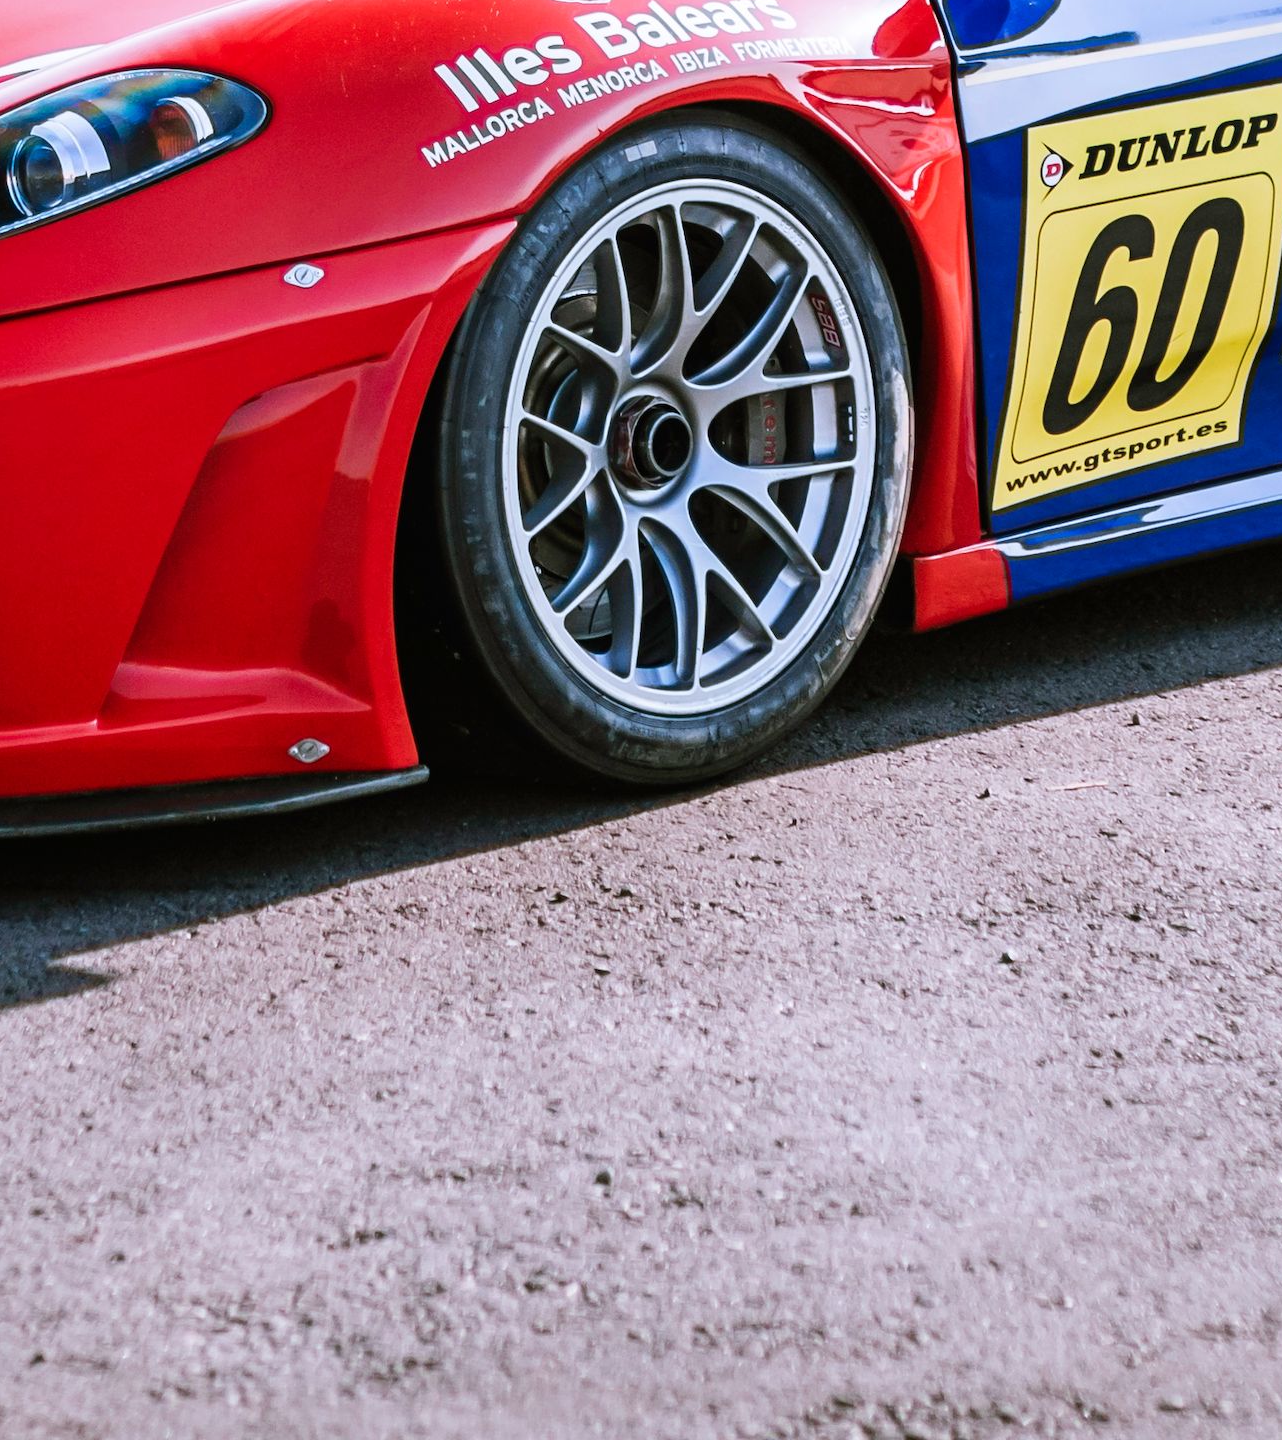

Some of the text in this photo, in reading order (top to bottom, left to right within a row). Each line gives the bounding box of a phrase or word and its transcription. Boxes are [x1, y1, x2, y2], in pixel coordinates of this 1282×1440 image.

[421, 34, 856, 169] MALLORCA MENORCA IBIZA FORMENTERA
[434, 34, 583, 113] Illes
[1078, 113, 1279, 180] DUNLOP
[1043, 197, 1245, 436] 60
[1005, 418, 1228, 493] www.gtsport.es
